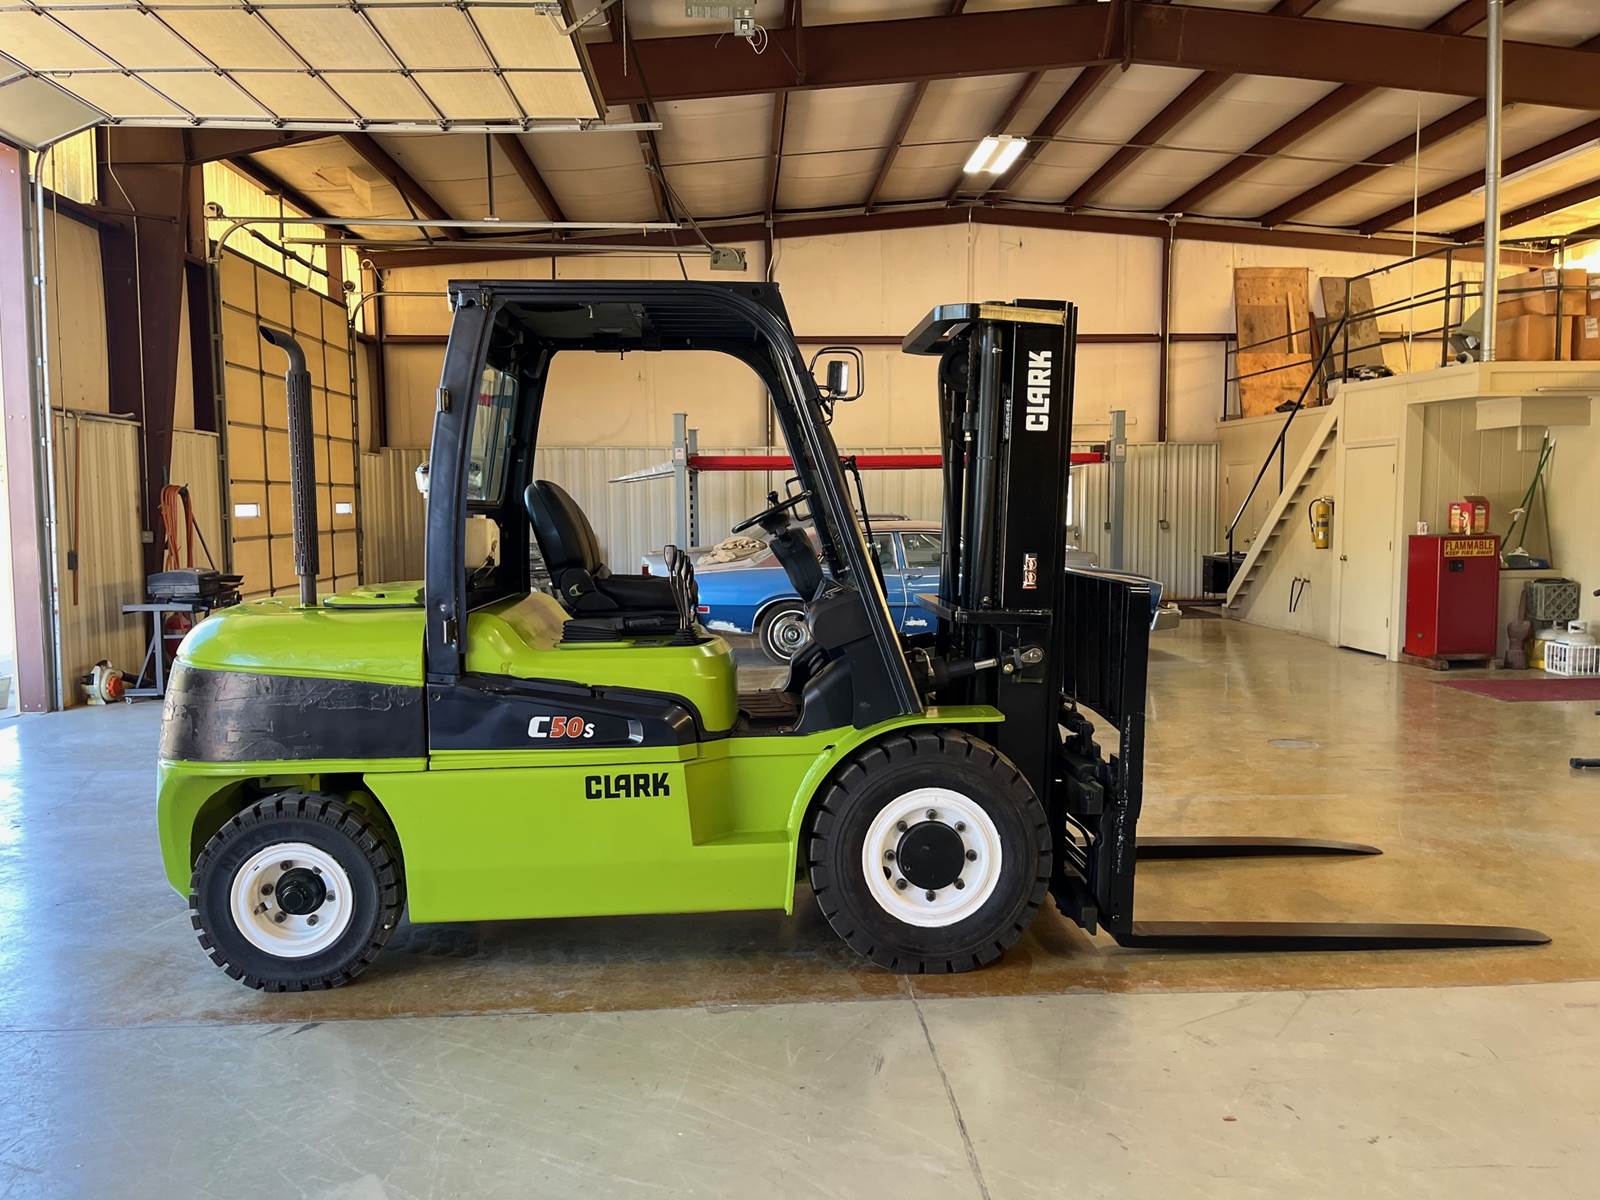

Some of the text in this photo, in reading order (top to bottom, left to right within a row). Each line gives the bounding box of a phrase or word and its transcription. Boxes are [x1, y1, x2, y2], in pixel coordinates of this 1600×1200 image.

[1026, 350, 1052, 431] CLARK
[1446, 540, 1493, 550] FLAMMABLE
[528, 716, 596, 738] C50s
[585, 772, 671, 799] CLARK
